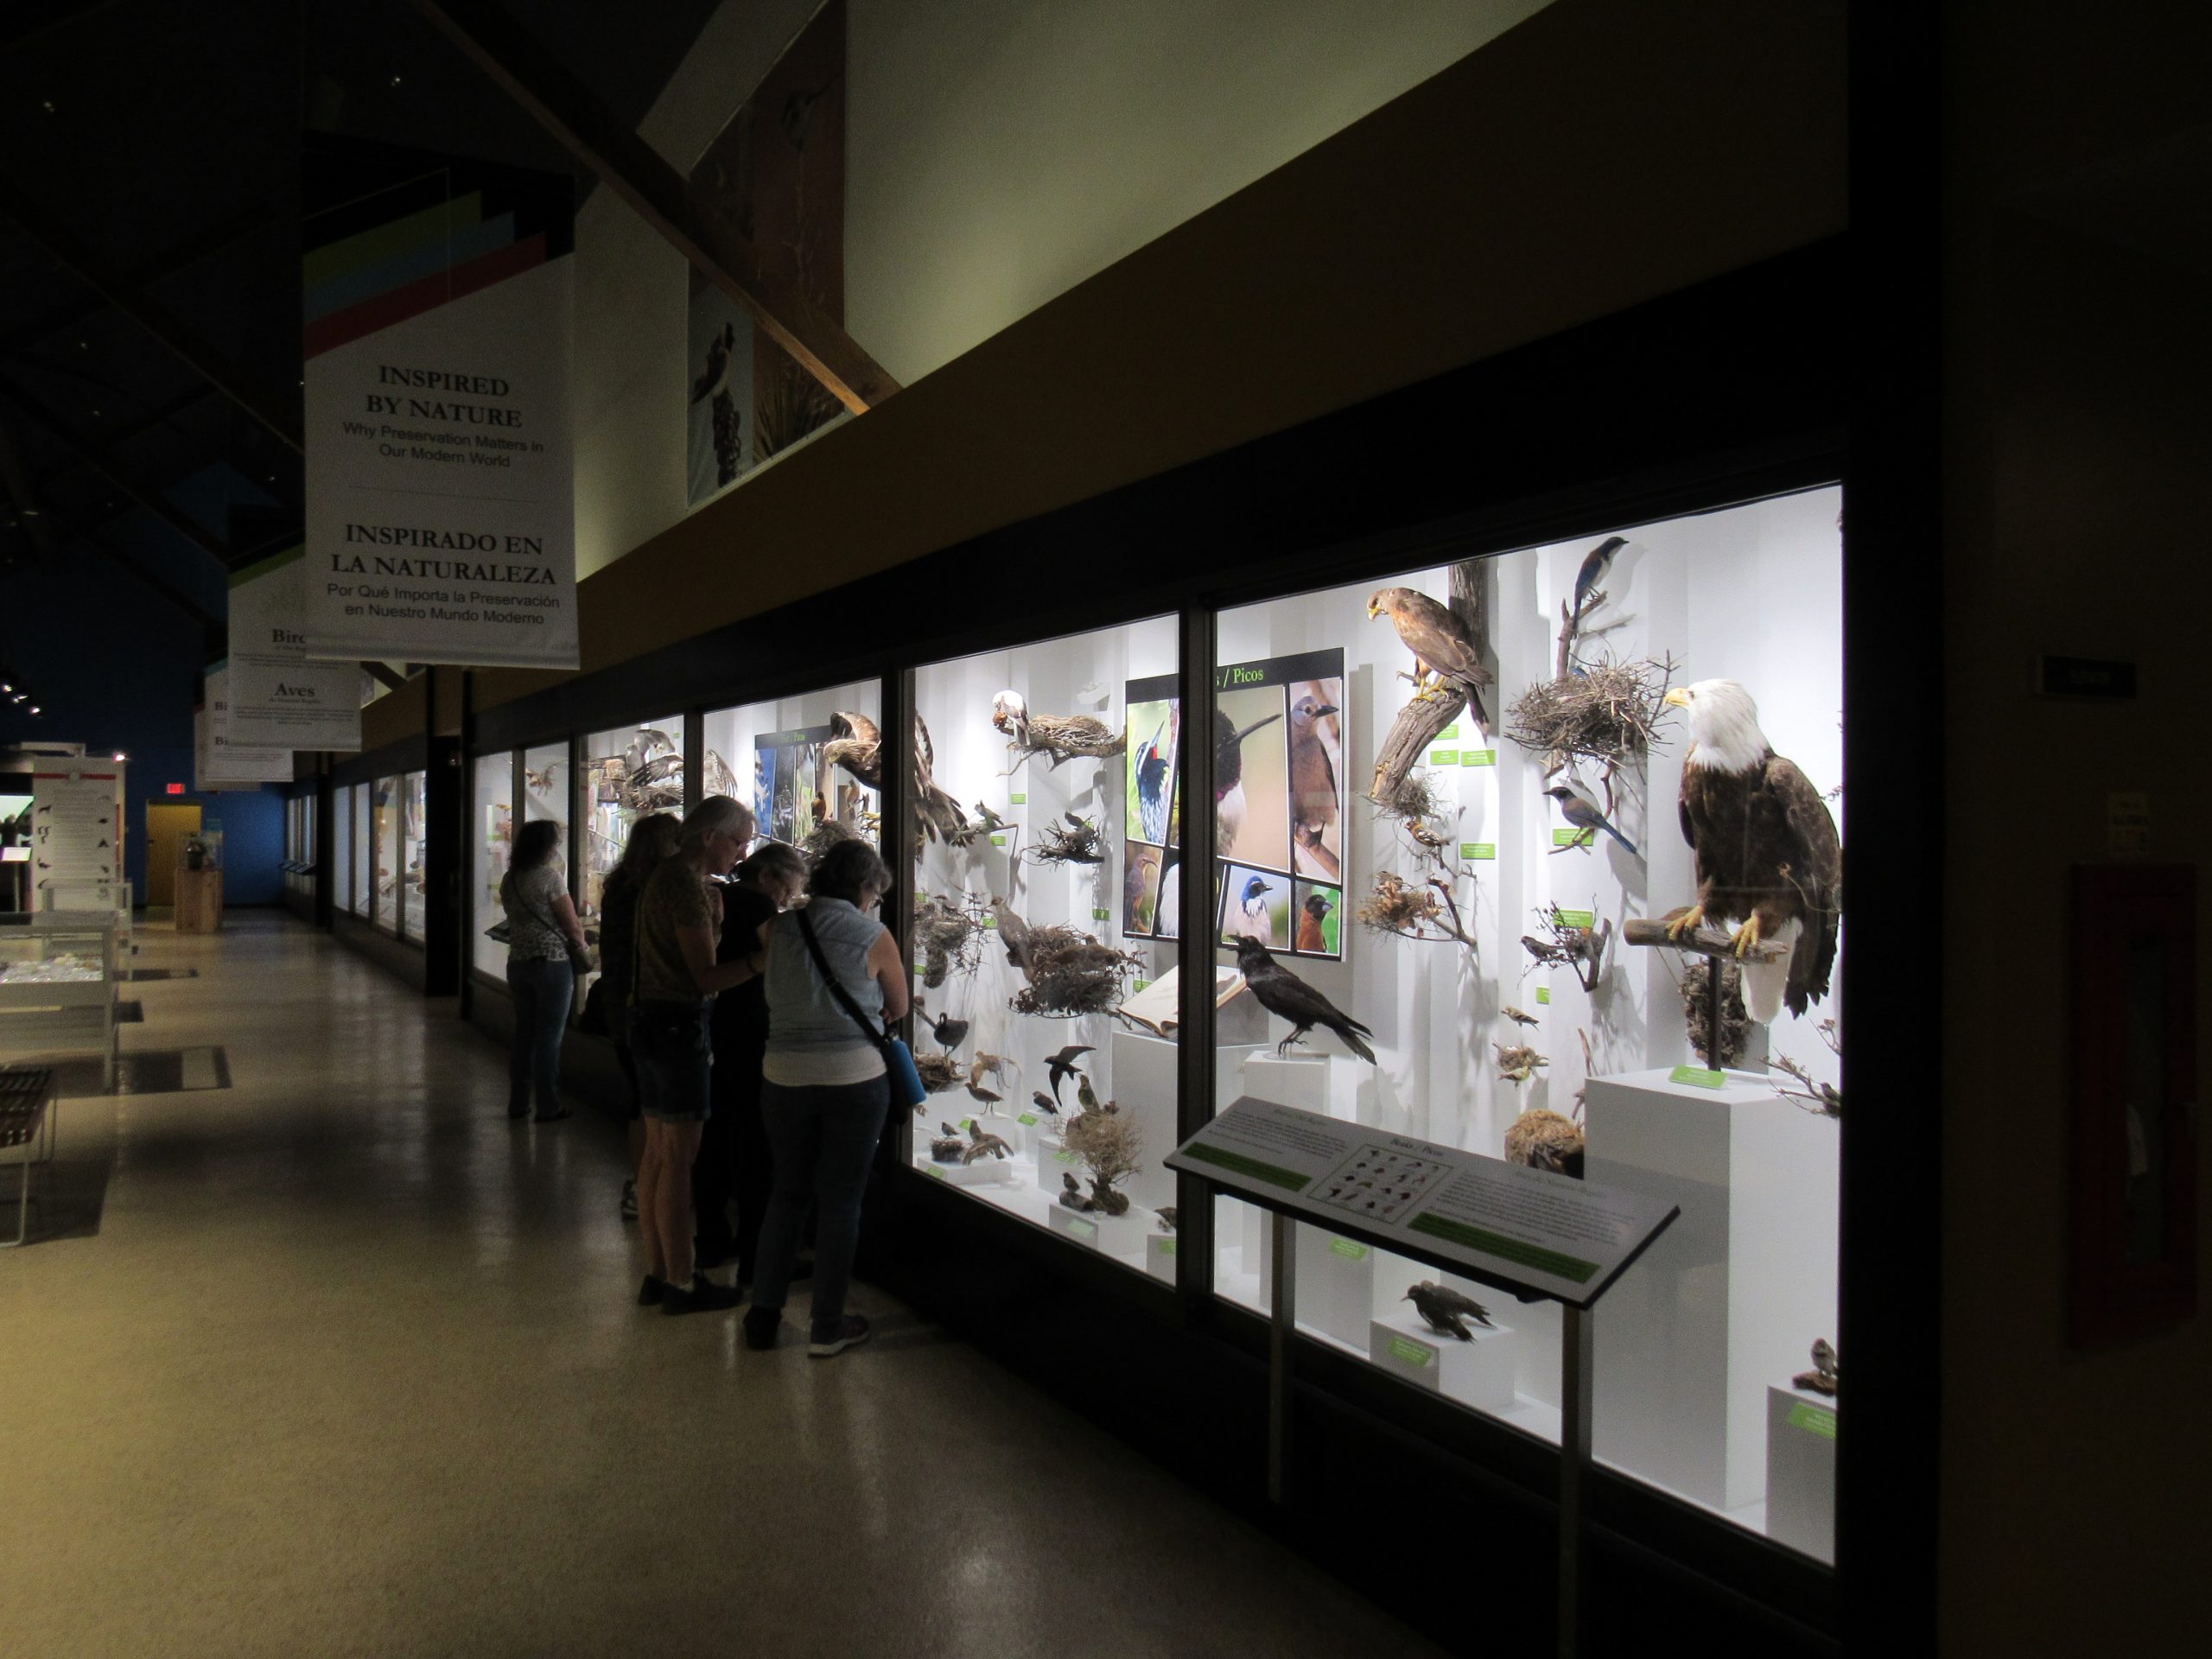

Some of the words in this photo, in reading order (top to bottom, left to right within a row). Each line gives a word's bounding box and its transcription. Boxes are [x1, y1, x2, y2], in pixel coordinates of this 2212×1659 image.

[378, 365, 510, 397] INSPIRED
[366, 394, 404, 416] BY
[410, 398, 524, 429] NATURE
[341, 421, 376, 440] Why
[381, 425, 472, 448] Preservation
[476, 435, 528, 452] Matters
[531, 440, 544, 454] in
[379, 443, 407, 458] Our
[411, 446, 466, 464] Modern
[470, 453, 512, 468] World
[346, 524, 498, 553] INSPIRADO
[504, 536, 544, 556] EN
[331, 554, 368, 575] LA
[374, 556, 557, 586] NATURALEZA
[327, 583, 353, 598] Por
[358, 584, 390, 600] Qué
[394, 587, 450, 606] Importa
[453, 590, 467, 604] la
[470, 591, 561, 609] Preservación
[345, 607, 365, 616] en
[368, 604, 427, 620] Nuestro
[430, 607, 480, 622] Mundo
[483, 610, 545, 626] Moderno
[1233, 667, 1264, 683] Picos
[273, 683, 316, 697] Aves
